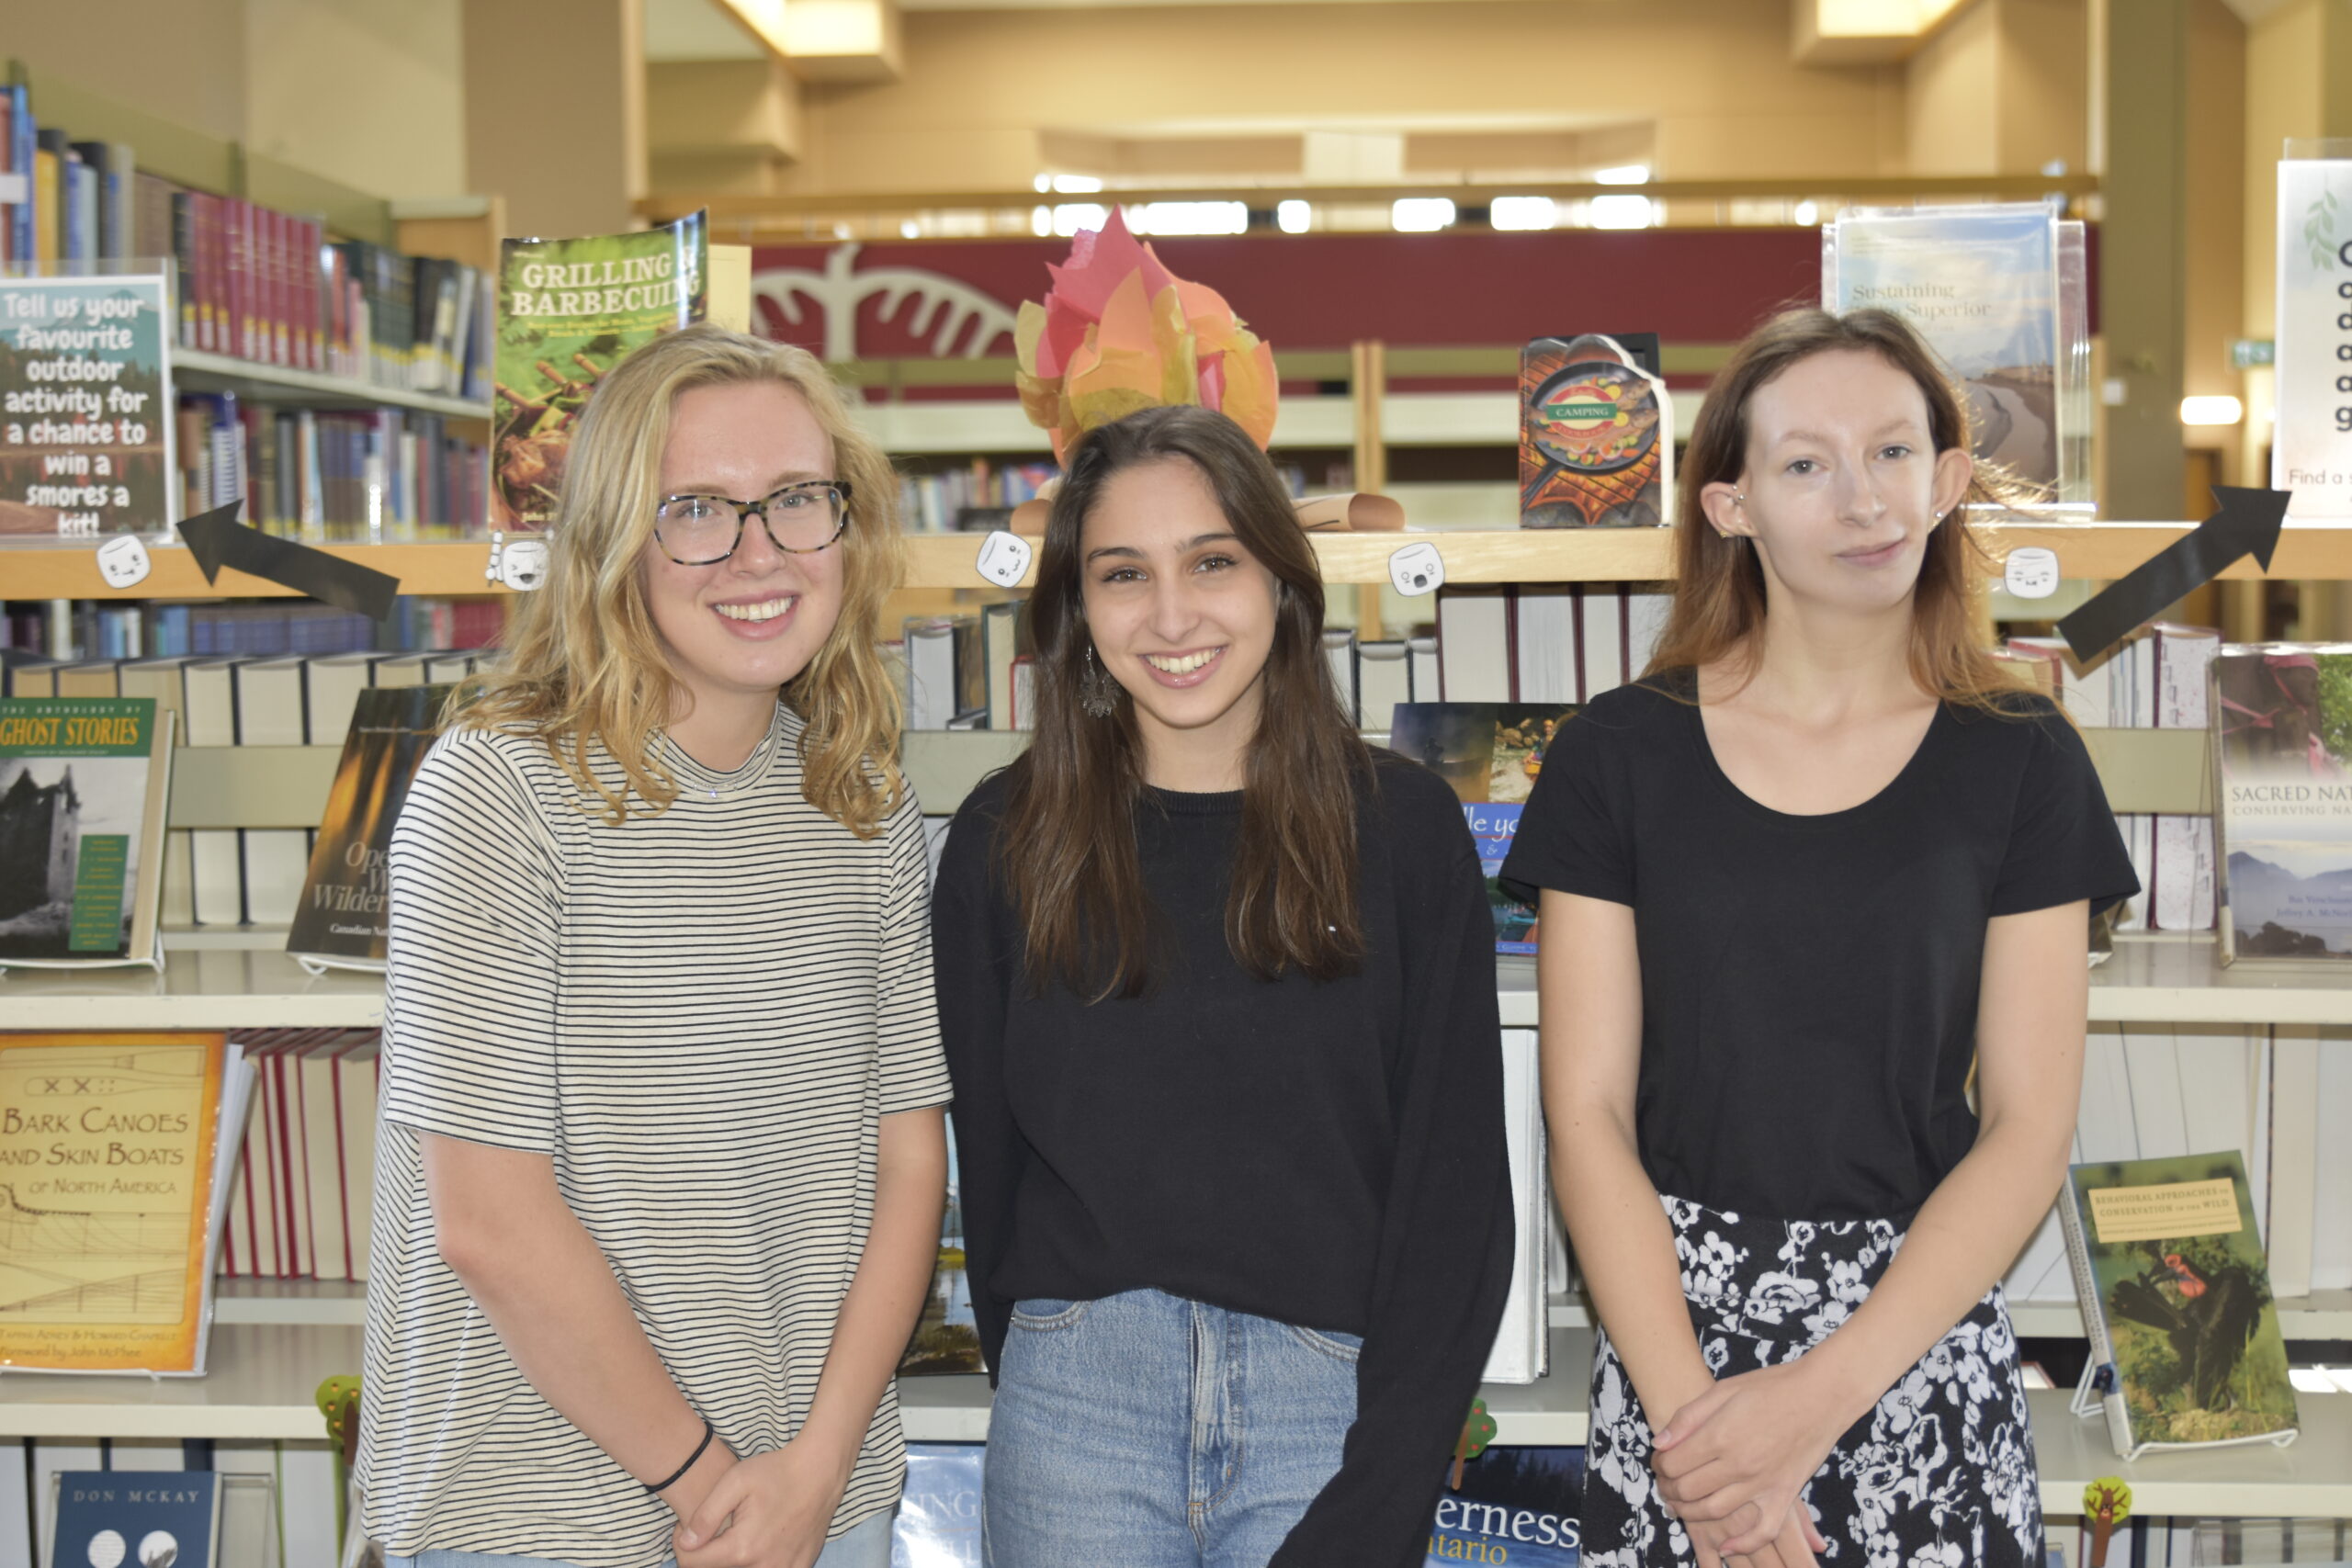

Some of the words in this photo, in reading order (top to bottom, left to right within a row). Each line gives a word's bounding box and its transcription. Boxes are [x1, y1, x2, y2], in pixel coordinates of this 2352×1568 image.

[522, 253, 673, 289] GRILLING
[512, 272, 700, 316] BARBECUIG
[1852, 281, 1956, 301] Sustaining
[4, 293, 45, 318] Tell
[53, 297, 79, 318] us
[85, 298, 145, 326] your
[1905, 301, 1992, 321] Superior
[16, 323, 133, 350] favourite
[27, 354, 125, 381] outdoor
[5, 386, 102, 421] activity
[107, 386, 149, 413] for
[1555, 407, 1609, 416] CAMPING
[7, 423, 24, 445] a
[28, 418, 115, 445] chance
[119, 418, 147, 446] to
[44, 449, 89, 475] win
[95, 454, 111, 476] a
[2289, 468, 2326, 485] Find
[2332, 473, 2343, 485] a
[26, 484, 109, 506] smores
[113, 485, 130, 507] a
[58, 512, 100, 533] kit!
[0, 717, 62, 746] GHOST
[64, 717, 140, 746] STORIES
[2232, 785, 2310, 801] SACRED
[2233, 806, 2325, 816] CONSERVING
[3, 1108, 71, 1134] BARK
[81, 1107, 188, 1134] CANOES
[46, 1143, 99, 1166] SKIN
[107, 1142, 184, 1166] BOATS
[55, 1178, 106, 1194] NORTH
[109, 1177, 176, 1194] AMERICA
[2096, 1193, 2153, 1205] BEHAVIORAL
[2154, 1187, 2217, 1201] APPROACHES
[2099, 1204, 2173, 1217] CONSERVATION
[2203, 1199, 2229, 1209] WILD
[74, 1490, 115, 1503] DON
[128, 1490, 198, 1503] MCKAY
[1434, 1498, 1580, 1548] erness
